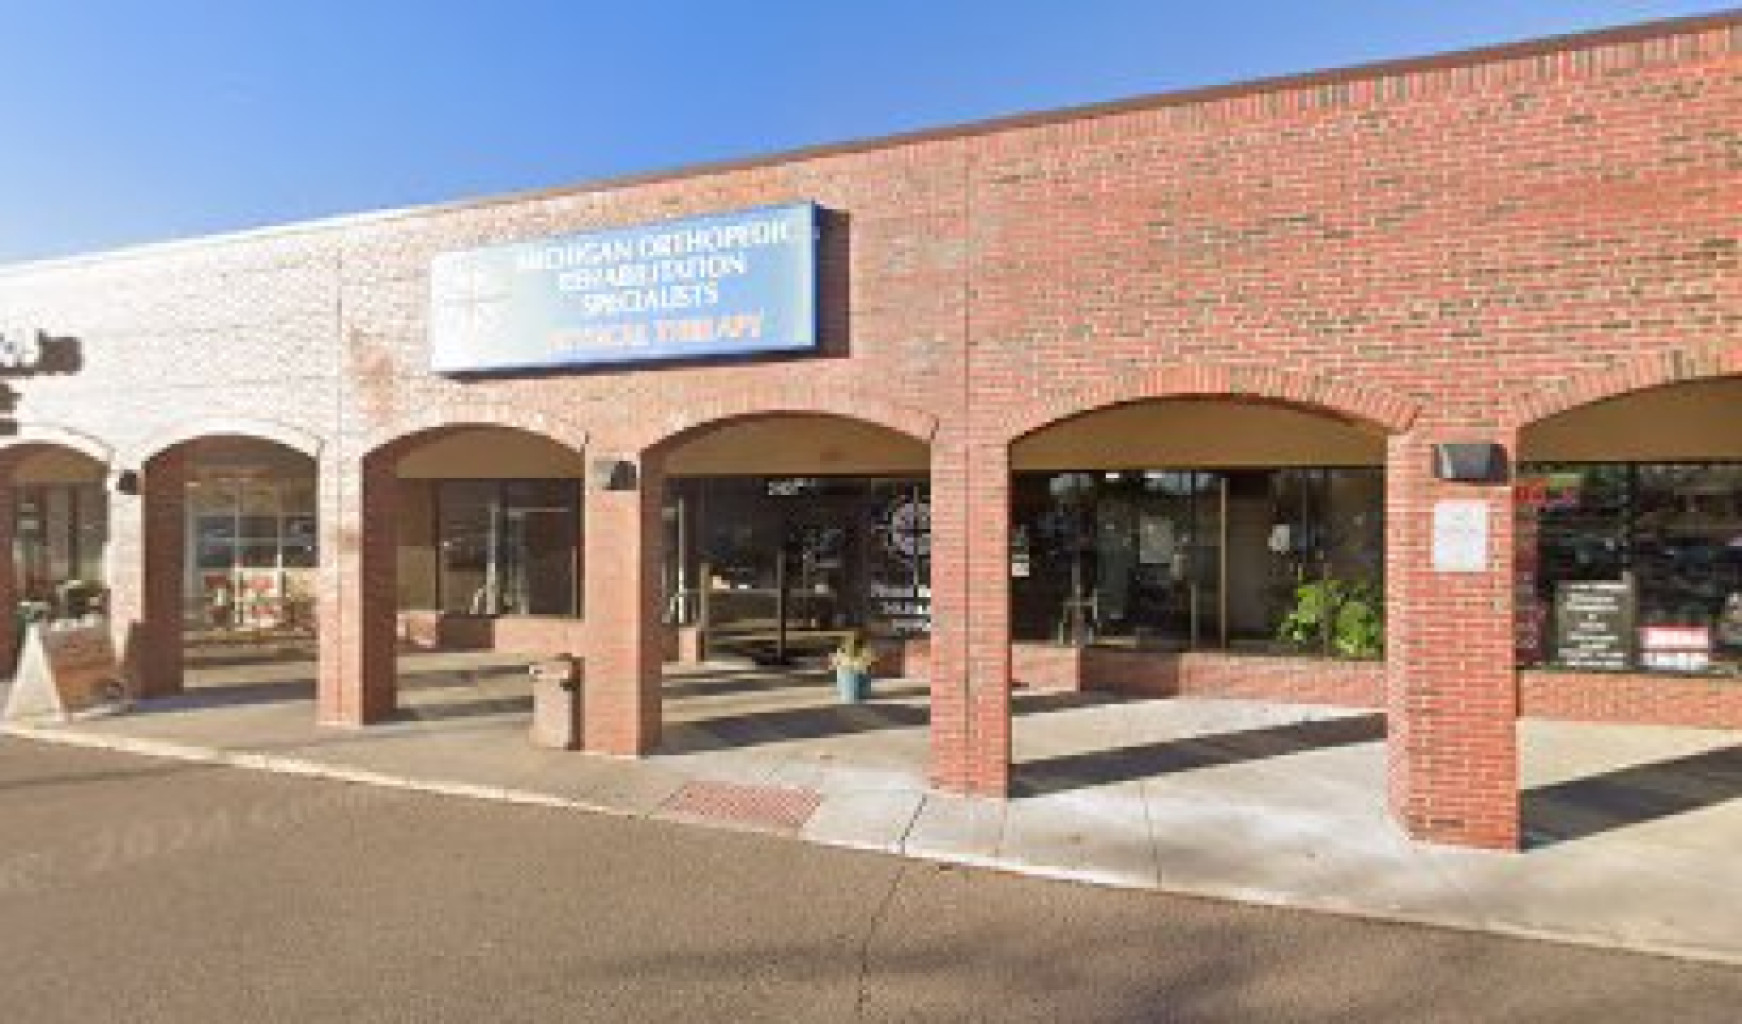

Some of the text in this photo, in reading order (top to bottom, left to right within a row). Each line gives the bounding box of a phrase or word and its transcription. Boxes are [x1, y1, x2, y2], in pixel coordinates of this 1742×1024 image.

[638, 219, 792, 257] ORTHOPEDIC
[558, 253, 748, 292] REHABILITATION
[582, 282, 719, 314] SPECIALISTS
